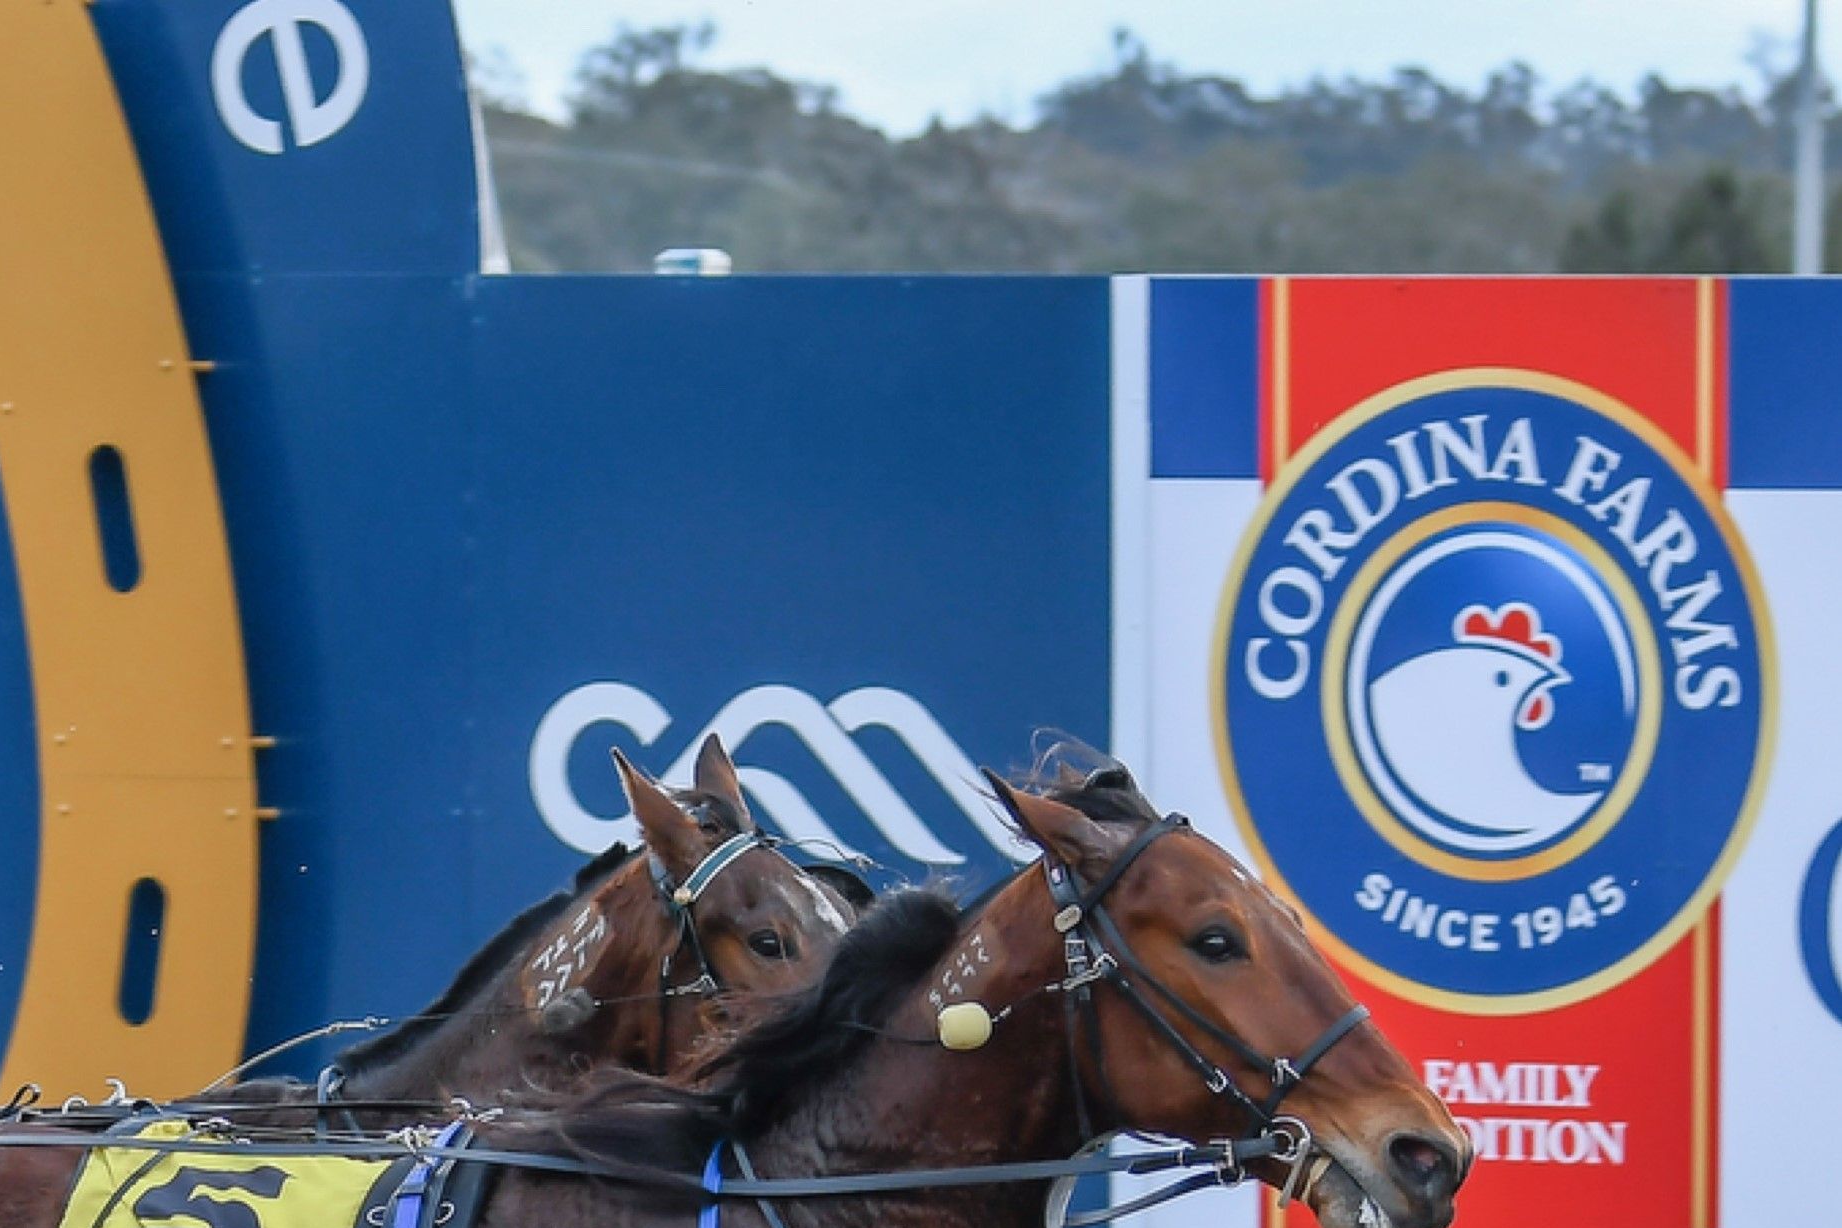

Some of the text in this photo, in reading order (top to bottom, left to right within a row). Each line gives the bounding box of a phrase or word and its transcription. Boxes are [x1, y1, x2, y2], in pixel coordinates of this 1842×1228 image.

[1244, 414, 1742, 710] CORDINA FARMS
[1354, 872, 1627, 951] SINCE 1945
[1422, 1058, 1602, 1108] FAMILY
